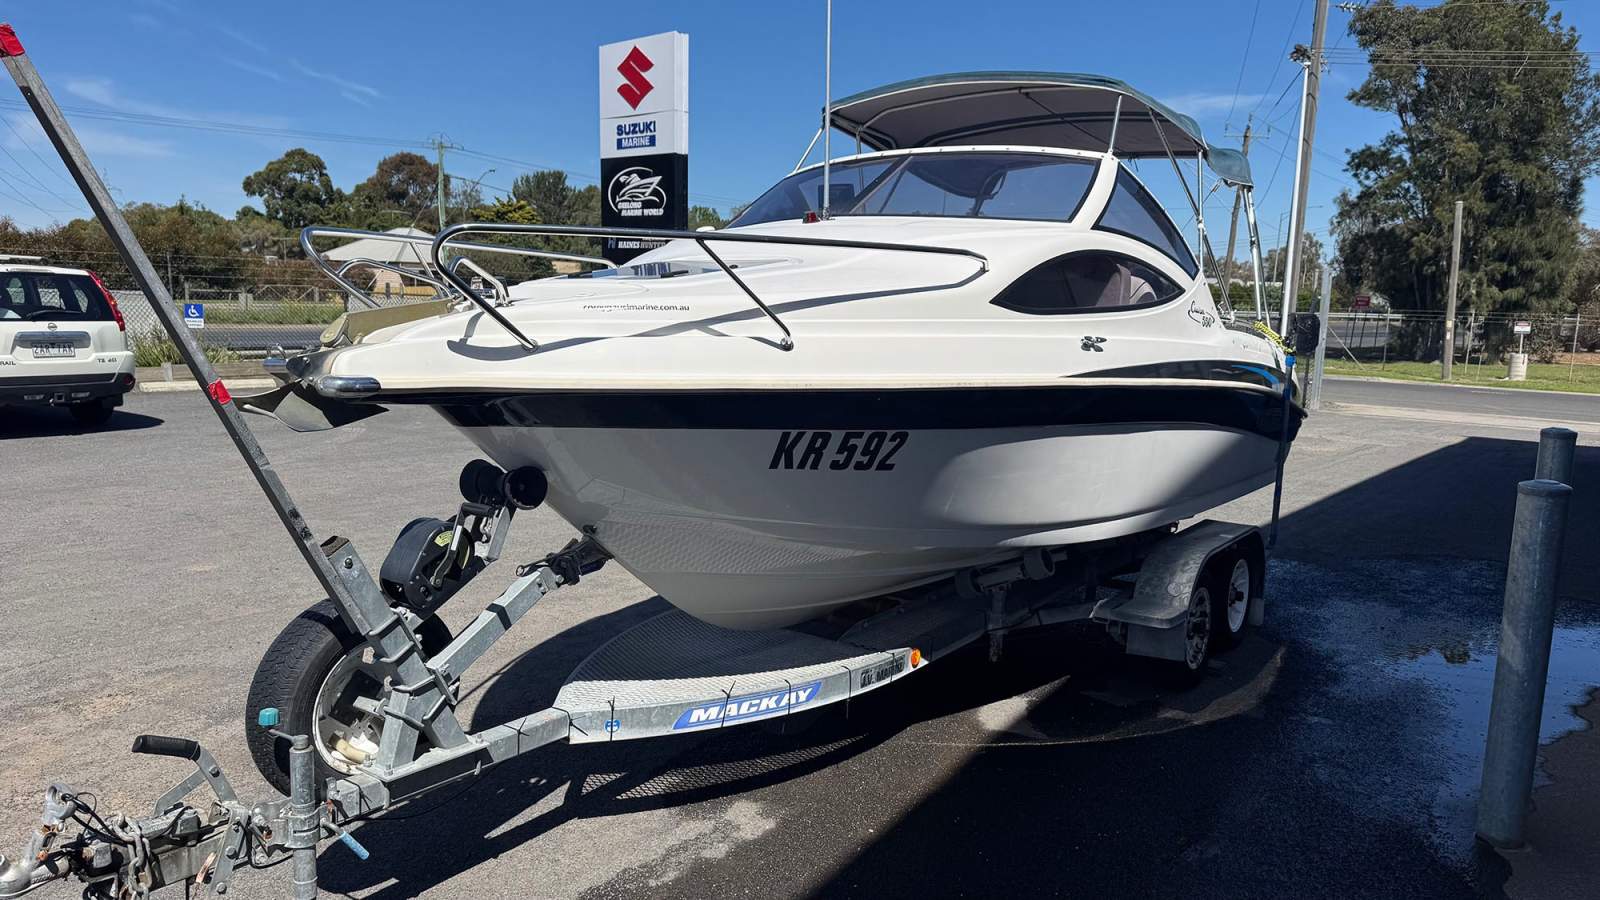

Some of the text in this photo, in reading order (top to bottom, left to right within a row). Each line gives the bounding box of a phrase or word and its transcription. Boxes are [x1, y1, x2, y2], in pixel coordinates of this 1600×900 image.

[616, 120, 656, 137] SUZUKI
[621, 135, 651, 148] MARINE
[617, 201, 642, 209] GEELONG
[621, 207, 664, 217] MARINE WORLD
[618, 240, 640, 249] HAINES
[768, 431, 909, 471] KR 592
[687, 687, 814, 724] MACKAY
